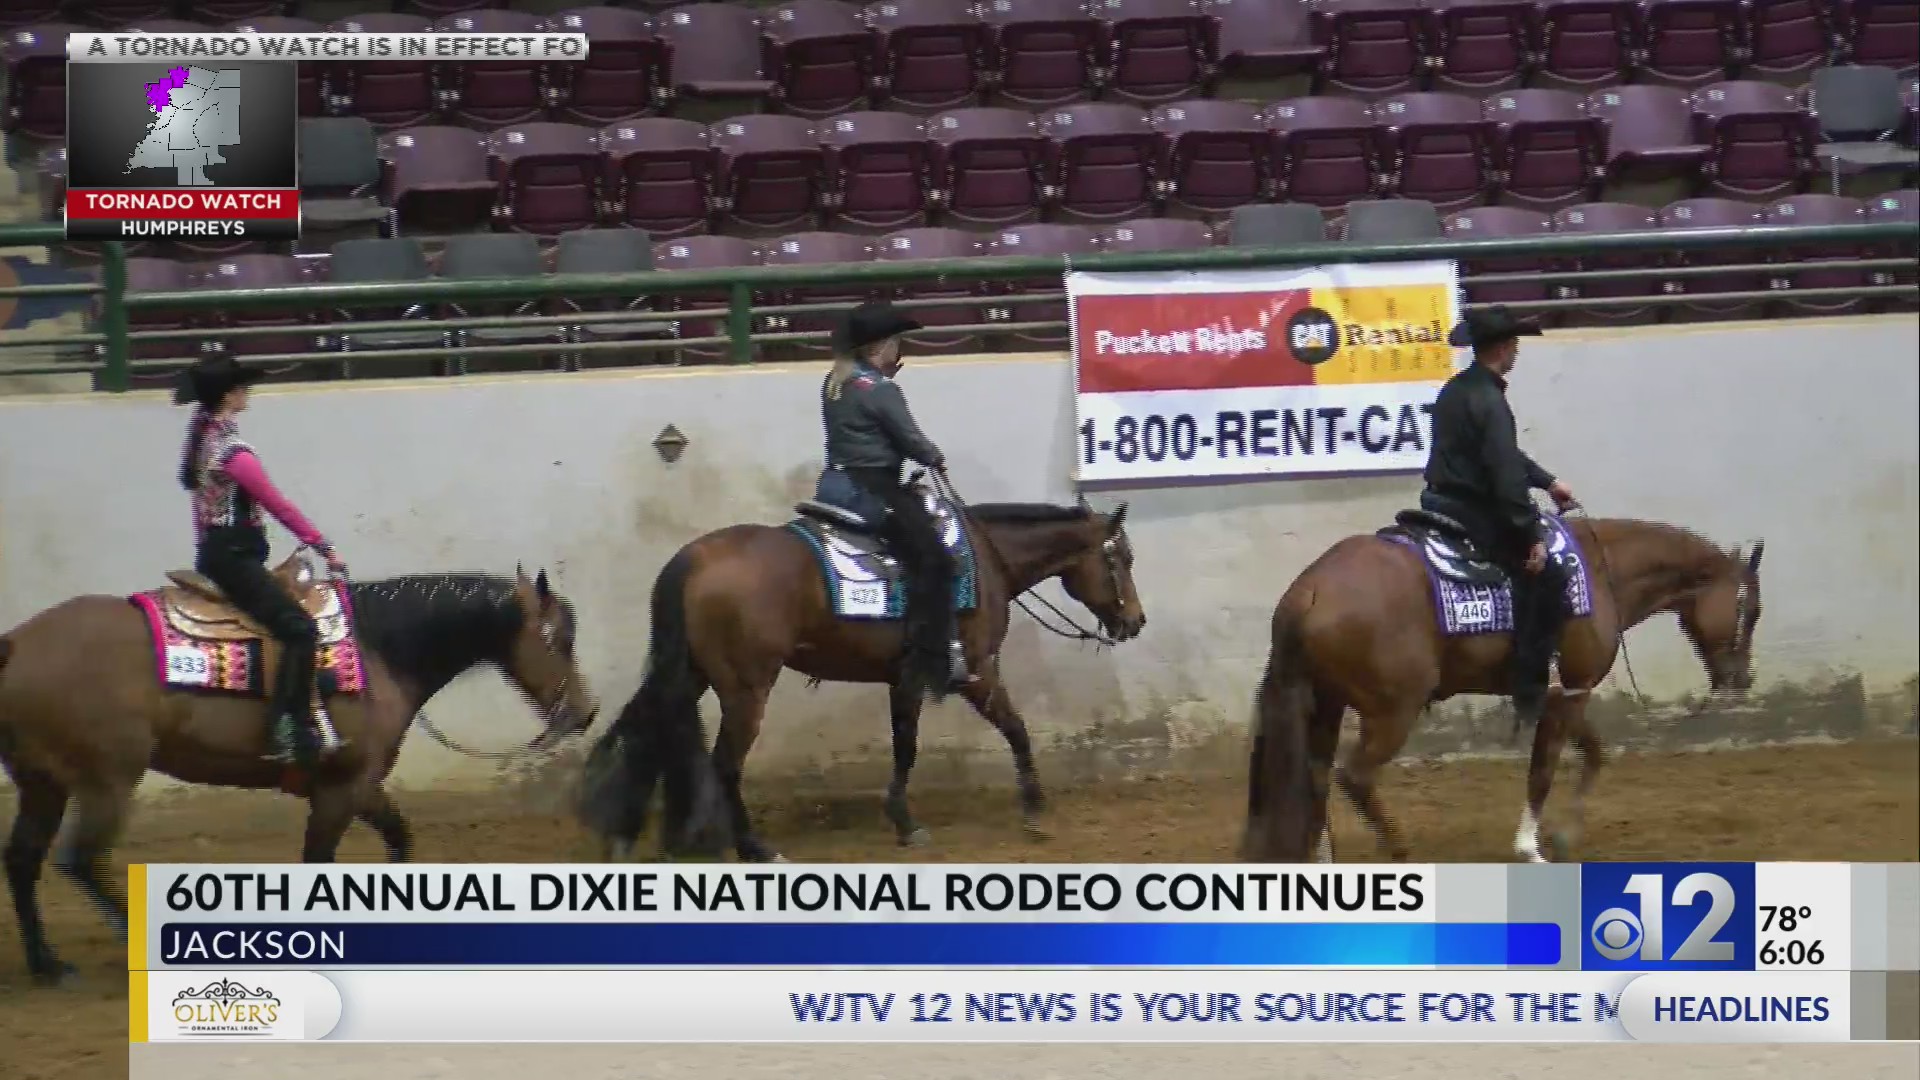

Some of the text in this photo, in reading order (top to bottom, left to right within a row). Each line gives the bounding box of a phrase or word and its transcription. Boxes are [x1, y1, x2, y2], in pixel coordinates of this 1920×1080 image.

[1095, 327, 1267, 355] Puckett Rents
[1291, 320, 1443, 349] CAT Rental
[850, 588, 880, 605] 422
[1460, 603, 1490, 619] 446
[170, 656, 206, 674] 433
